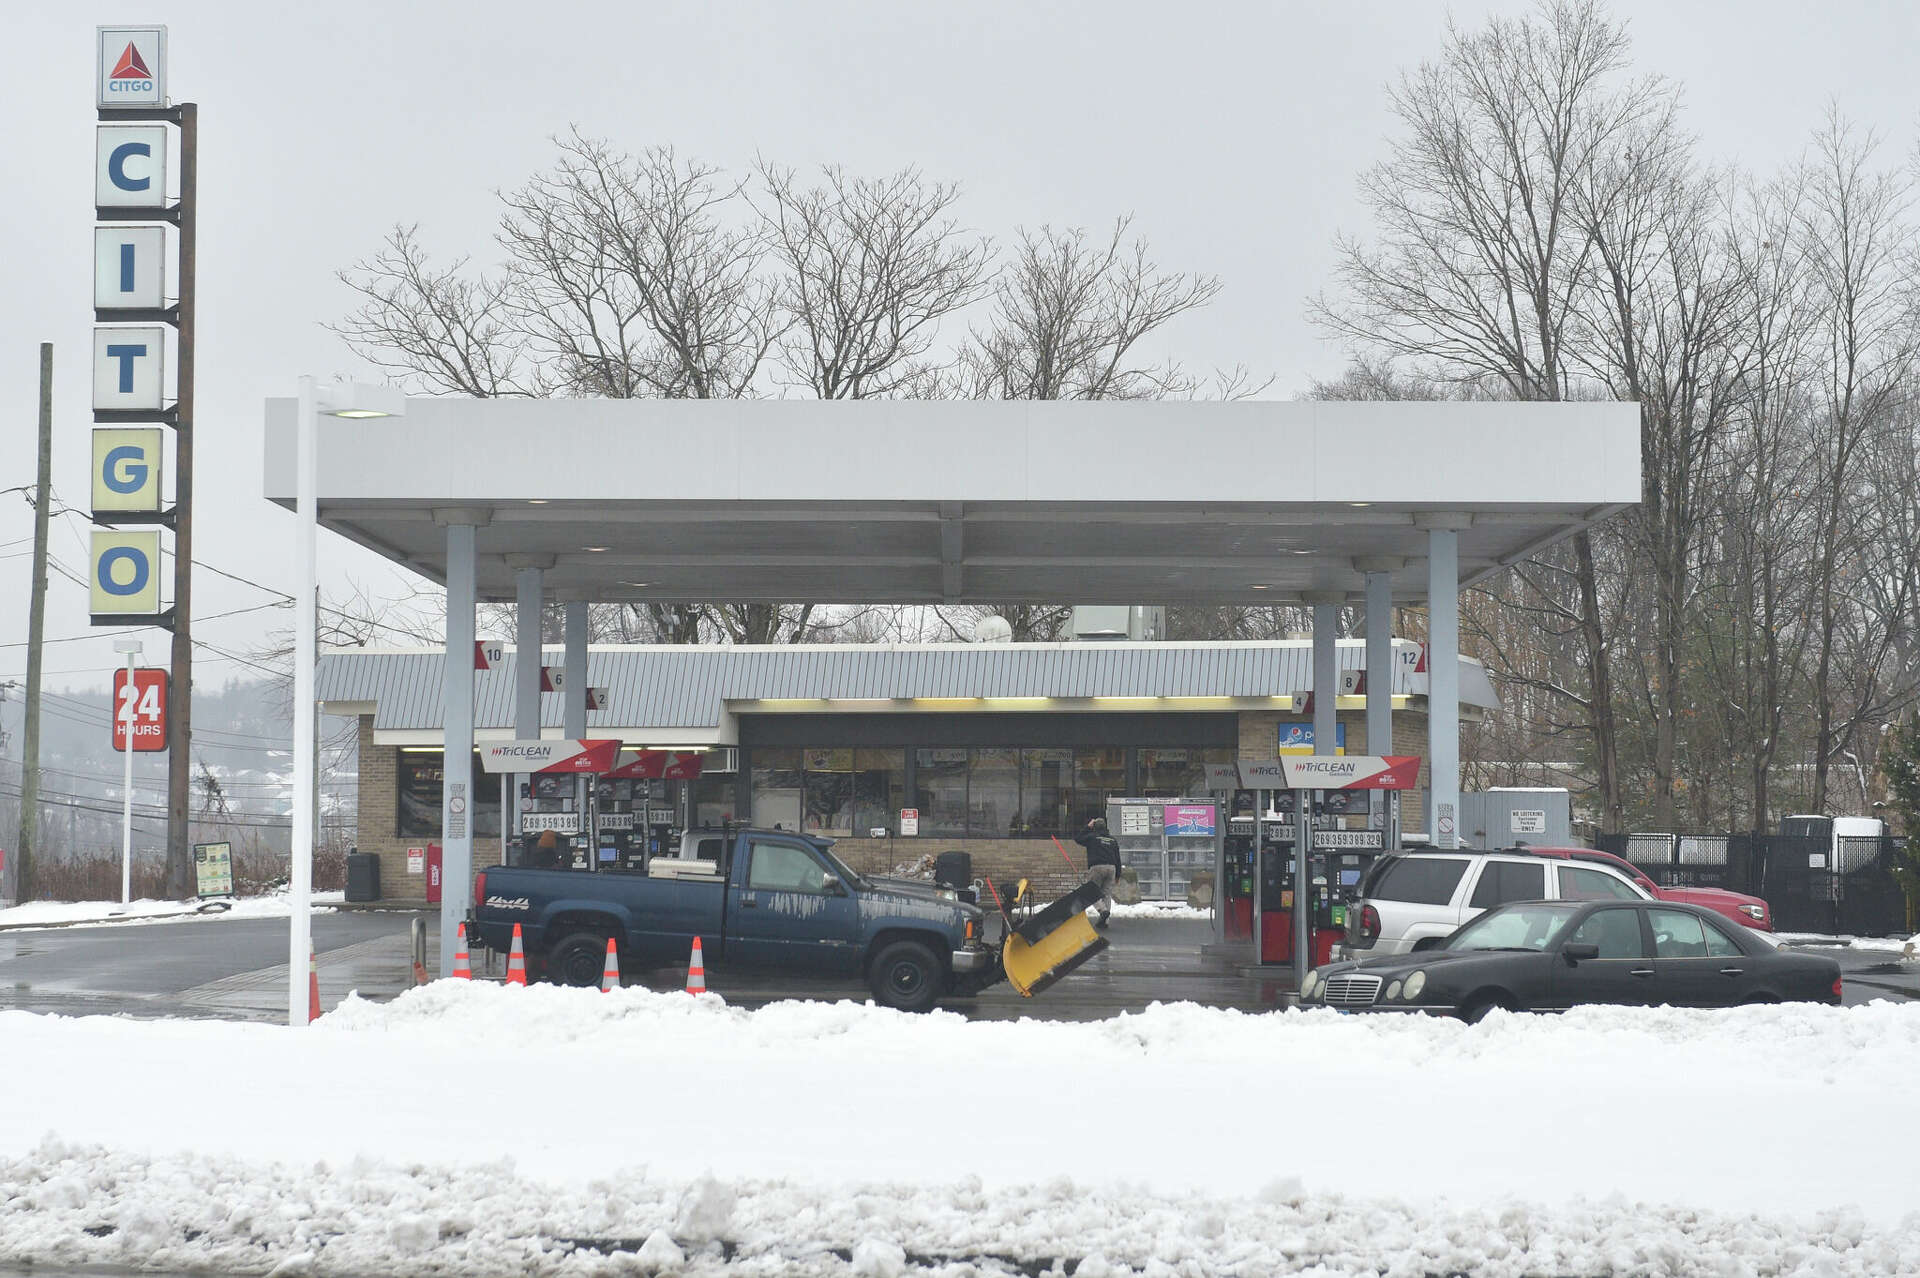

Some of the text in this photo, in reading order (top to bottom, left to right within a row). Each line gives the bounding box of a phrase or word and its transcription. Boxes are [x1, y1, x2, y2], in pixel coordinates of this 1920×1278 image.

[109, 80, 153, 92] CITGO
[487, 650, 501, 661] 10
[1402, 652, 1416, 665] 12
[556, 674, 562, 685] 6
[1346, 678, 1352, 688] 8
[117, 684, 161, 721] 24
[599, 695, 605, 704] 2
[1296, 697, 1302, 706] 4
[1305, 763, 1355, 773] TriCLEAN
[523, 817, 540, 828] 269
[542, 817, 558, 828] 359
[560, 817, 577, 828] 389
[1315, 833, 1381, 846] 269 359 389 329
